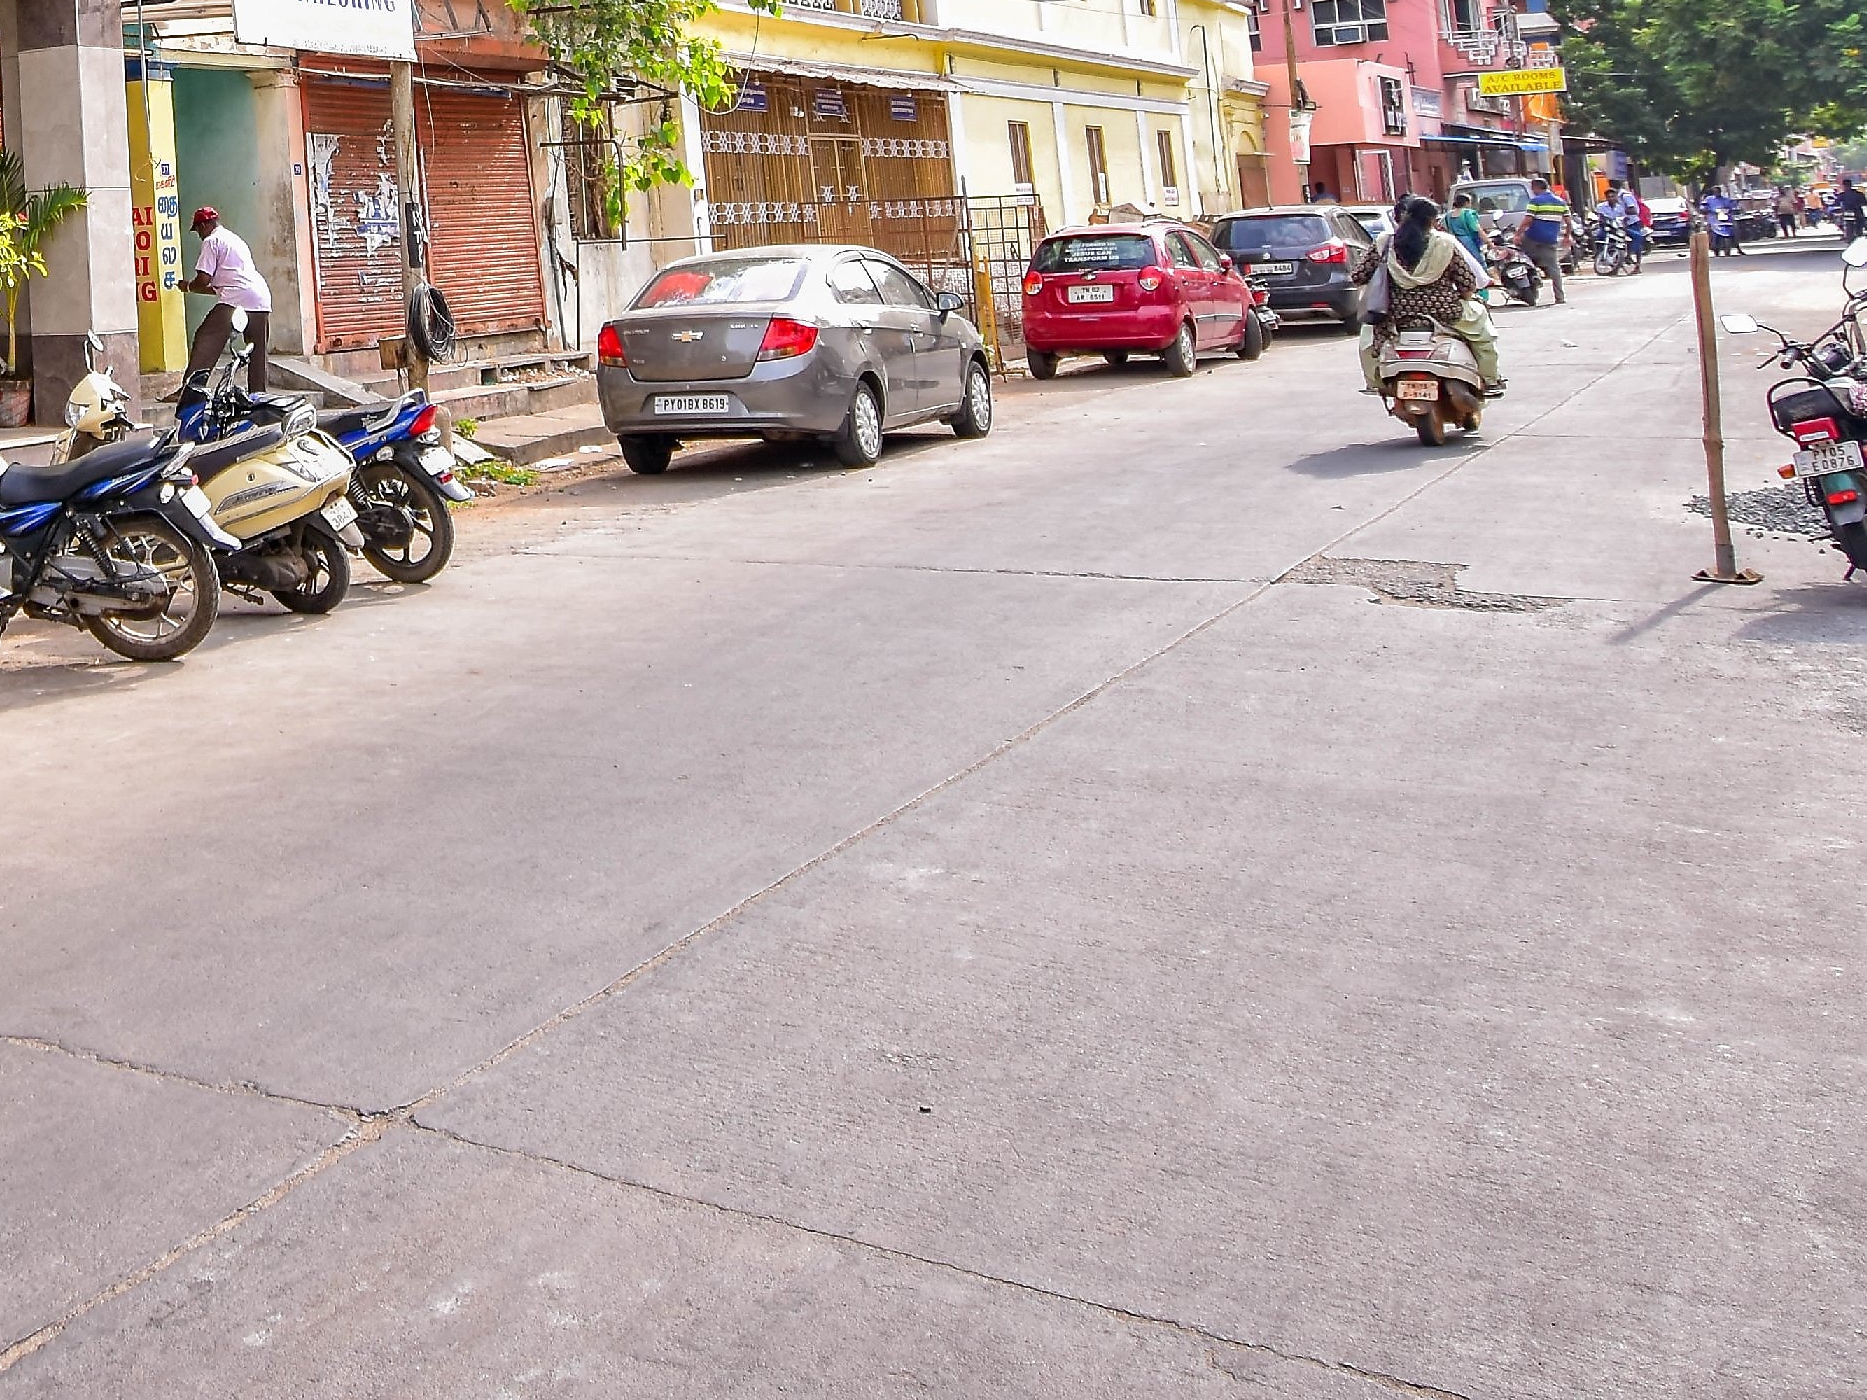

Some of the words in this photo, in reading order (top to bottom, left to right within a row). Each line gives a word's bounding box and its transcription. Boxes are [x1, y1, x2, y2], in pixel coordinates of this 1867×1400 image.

[1486, 74, 1508, 84] A/C
[1513, 70, 1557, 80] ROOMS
[1484, 80, 1563, 94] AVAILABLE
[1064, 255, 1108, 263] TRANSFORM
